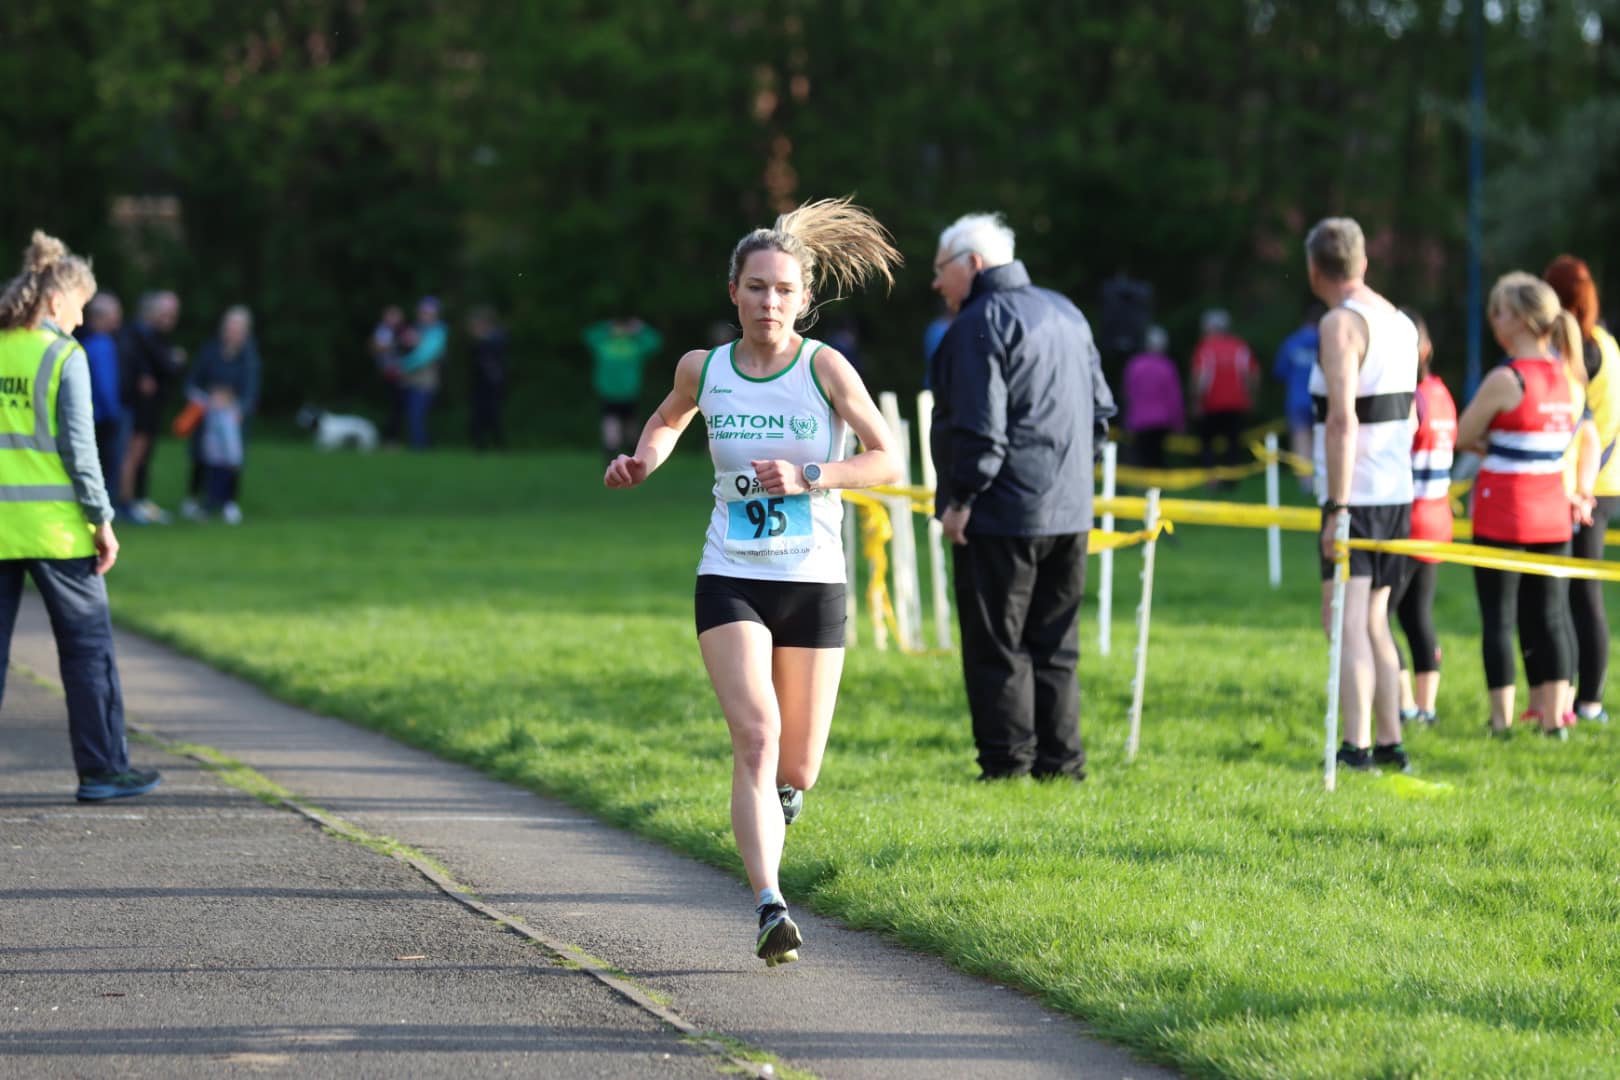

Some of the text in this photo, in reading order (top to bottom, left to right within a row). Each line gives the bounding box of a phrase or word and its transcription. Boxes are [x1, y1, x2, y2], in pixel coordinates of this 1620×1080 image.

[705, 414, 784, 429] HEATON
[715, 429, 763, 440] Harriers
[745, 497, 787, 539] 95
